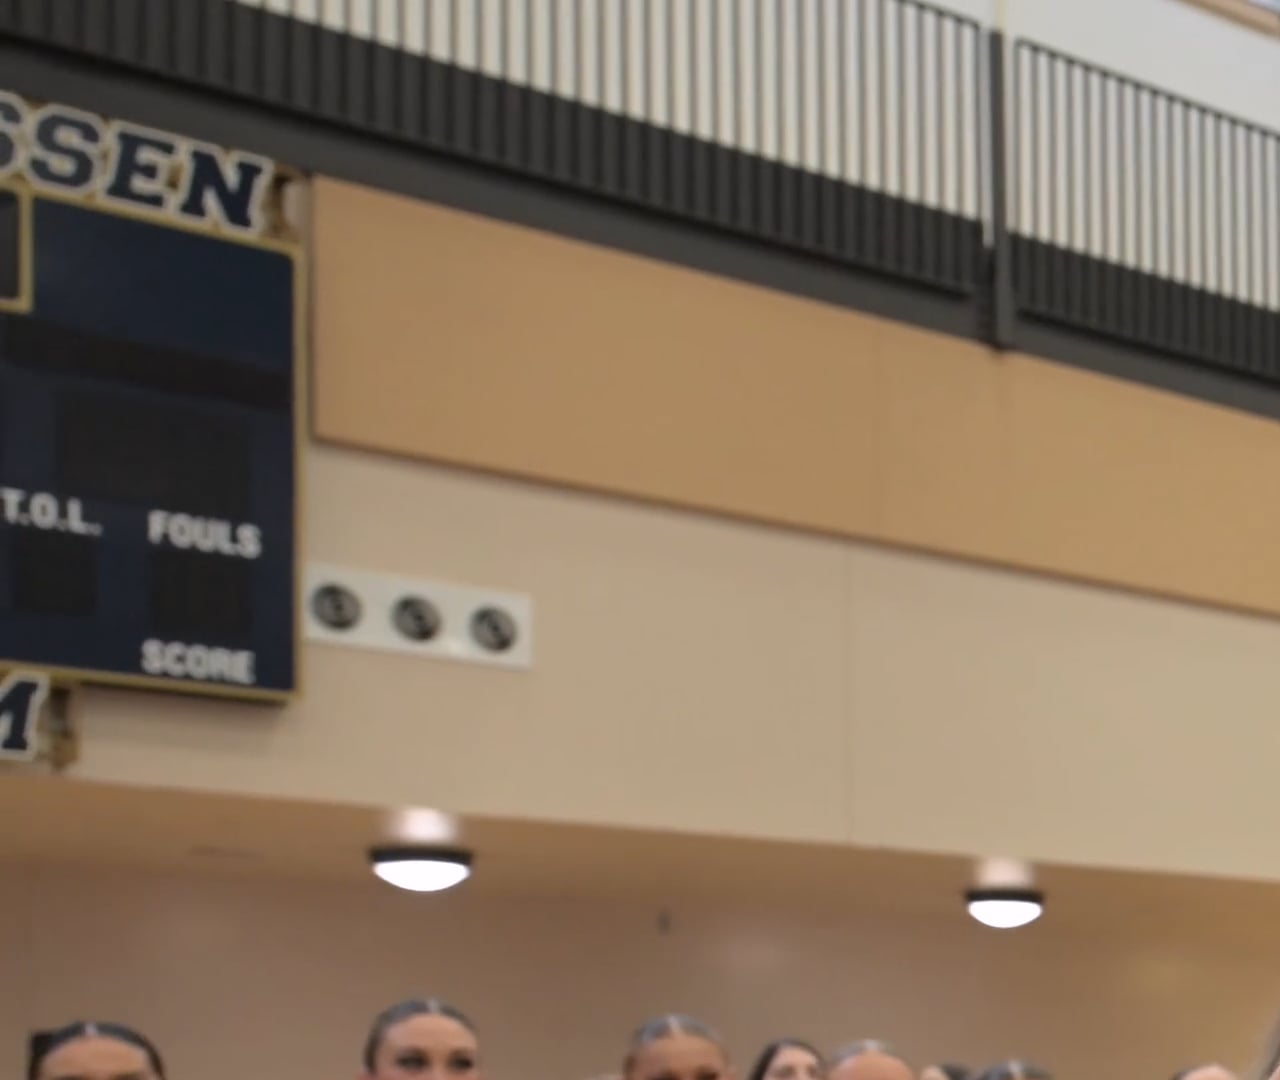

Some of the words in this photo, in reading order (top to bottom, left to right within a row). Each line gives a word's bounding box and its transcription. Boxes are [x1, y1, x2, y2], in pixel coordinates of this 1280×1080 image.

[0, 487, 103, 537] T.O.L.
[147, 508, 262, 560] FOULS
[140, 637, 256, 685] SCORE
